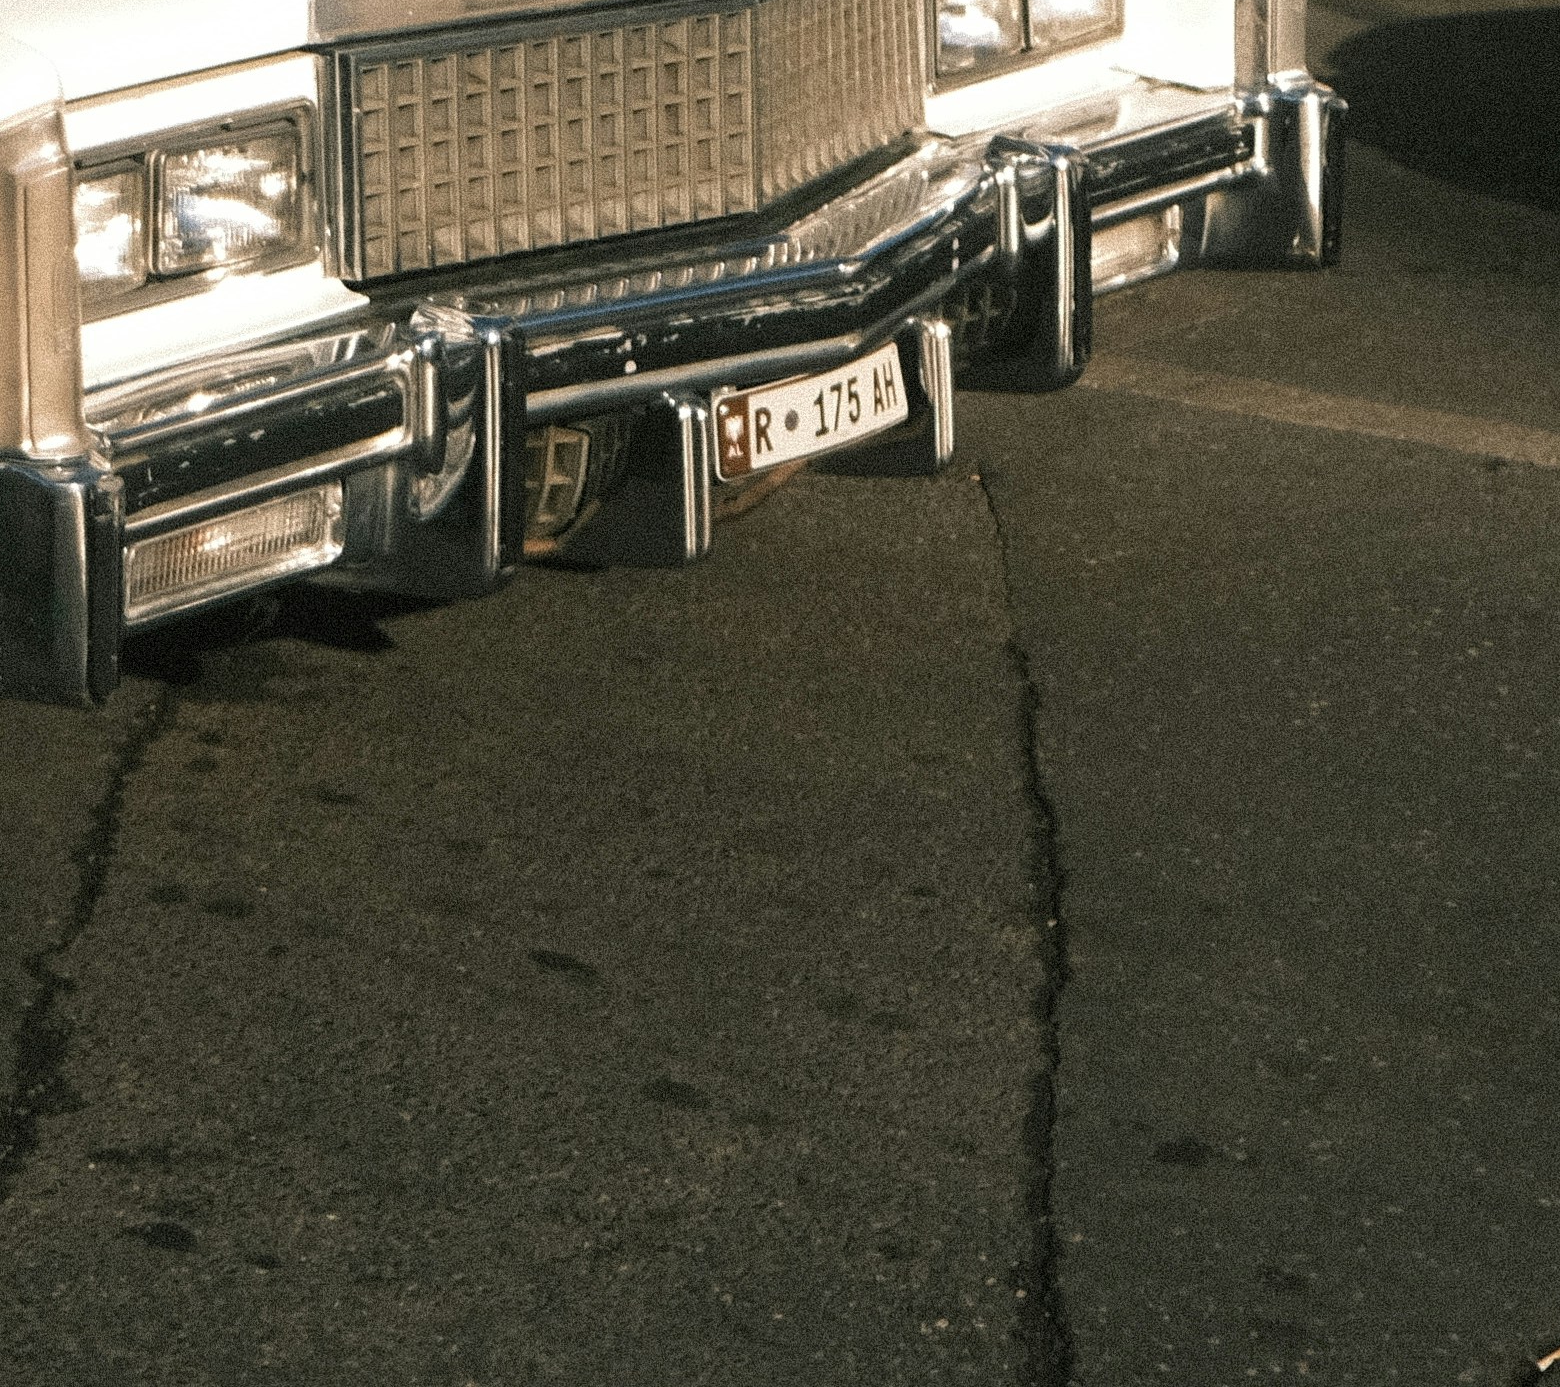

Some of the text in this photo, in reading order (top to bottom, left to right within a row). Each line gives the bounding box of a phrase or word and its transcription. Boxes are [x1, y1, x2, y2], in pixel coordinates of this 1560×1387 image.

[755, 361, 898, 454] R 175 AH
